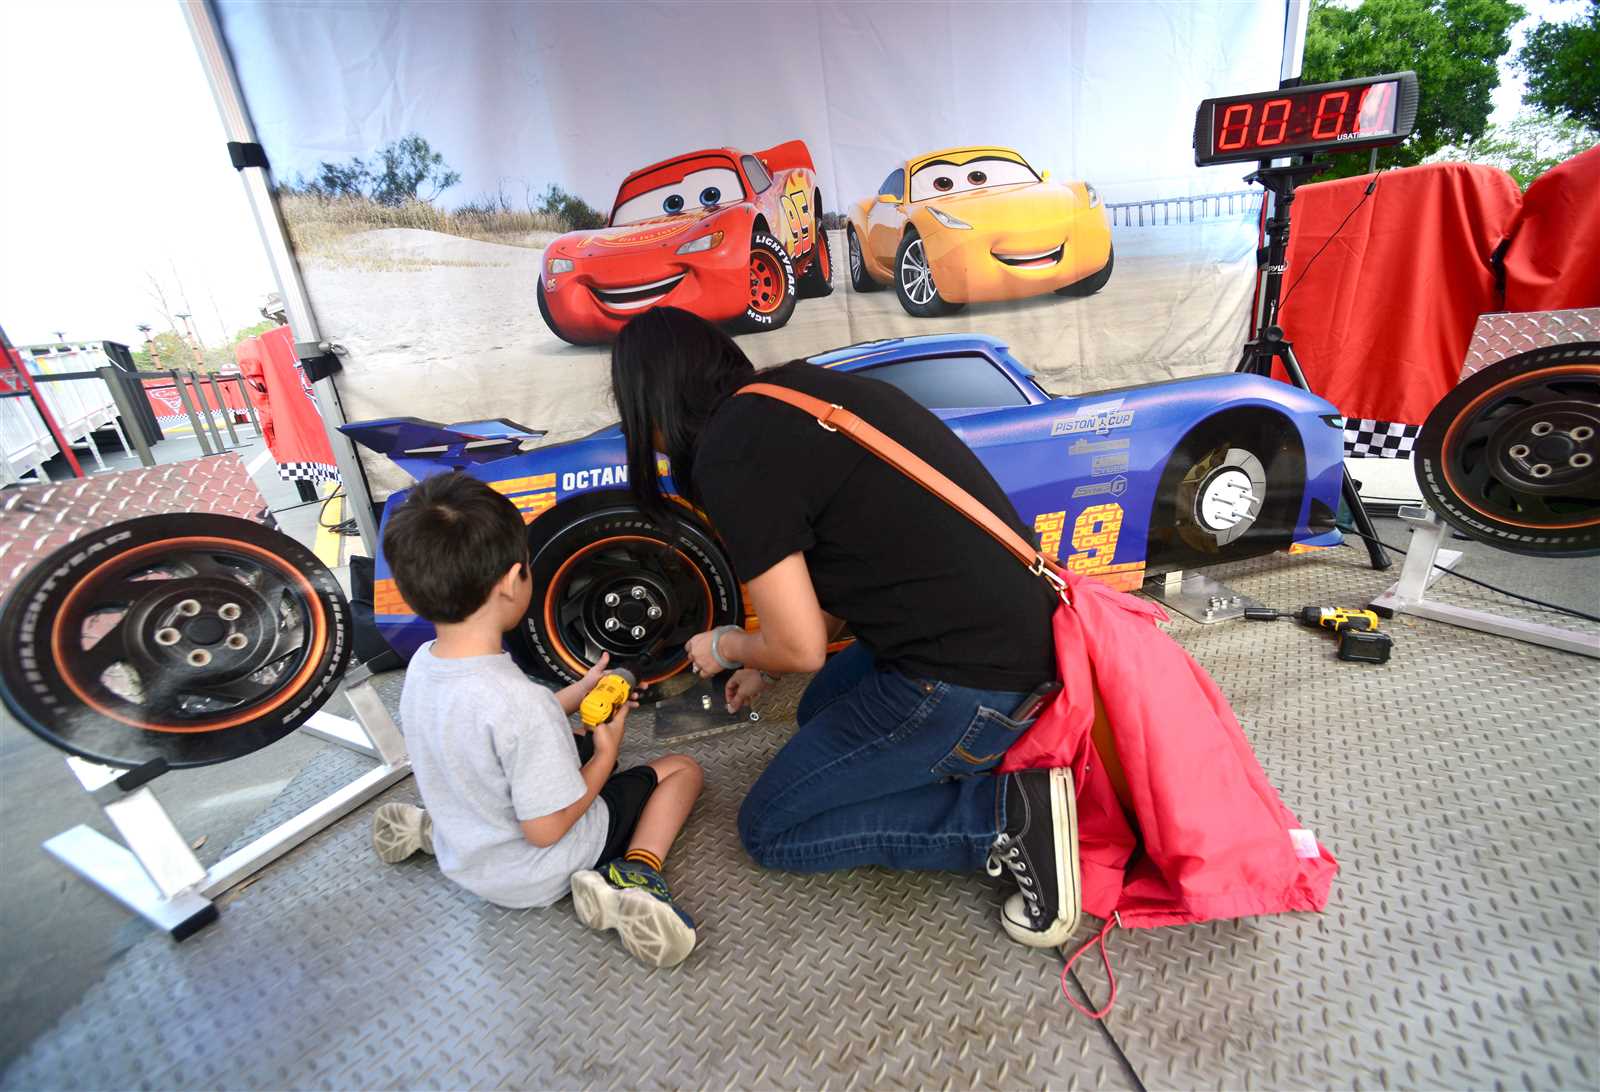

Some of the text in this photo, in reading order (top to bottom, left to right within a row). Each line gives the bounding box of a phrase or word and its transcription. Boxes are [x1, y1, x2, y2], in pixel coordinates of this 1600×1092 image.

[755, 234, 796, 296] LIGHTYEAR
[1055, 414, 1131, 432] PISTON CUP
[1034, 502, 1124, 576] 19
